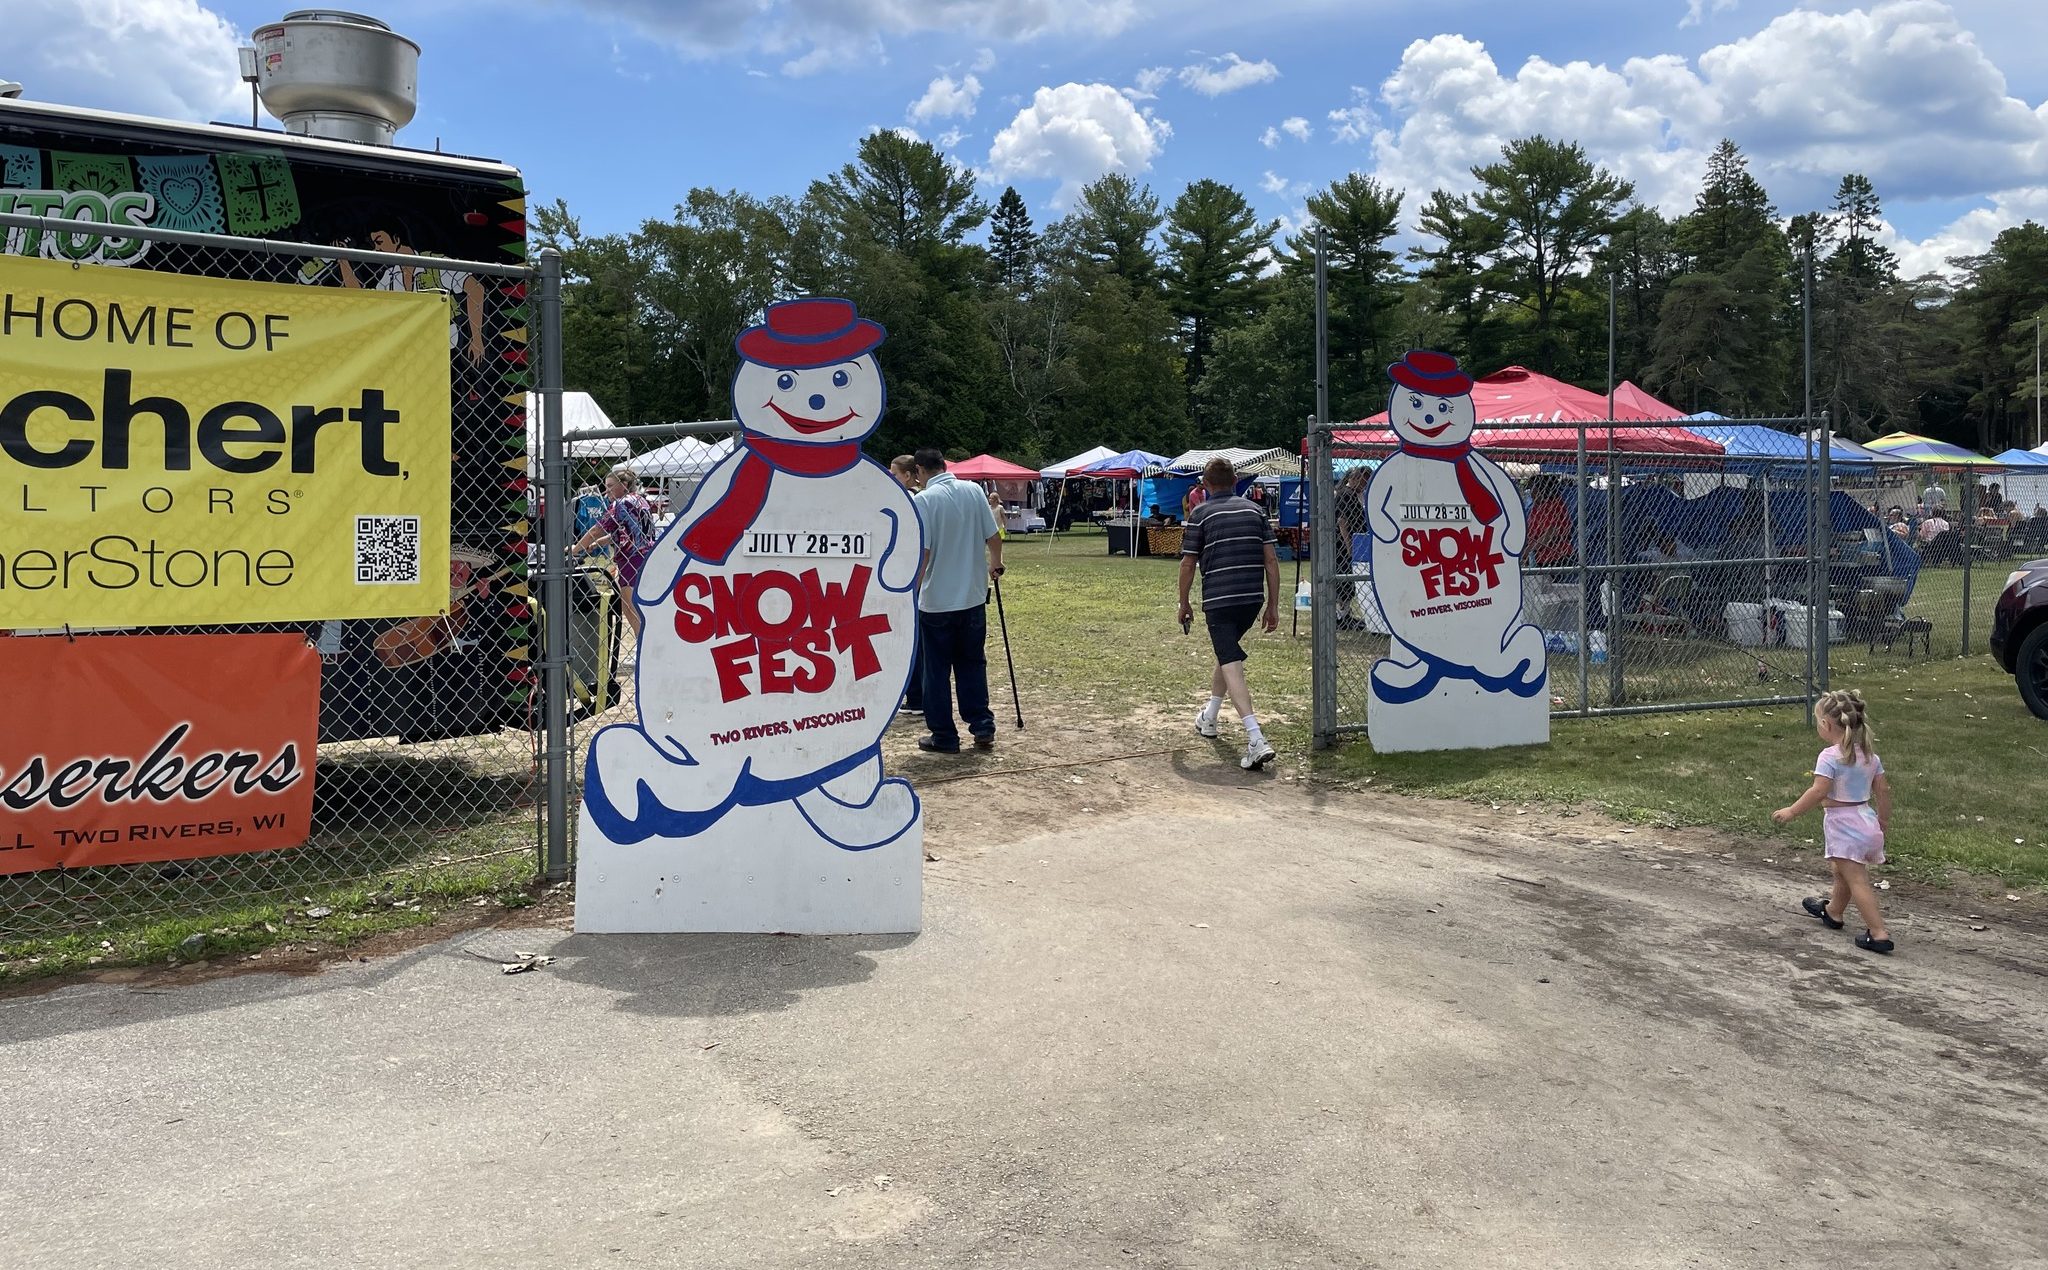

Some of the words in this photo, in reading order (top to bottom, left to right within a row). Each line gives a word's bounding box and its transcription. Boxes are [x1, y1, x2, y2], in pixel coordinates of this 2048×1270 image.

[4, 294, 194, 348] HOME
[215, 311, 290, 352] OF
[1403, 505, 1432, 520] JULY
[1434, 505, 1468, 520] 28-30
[748, 533, 797, 553] JULY
[806, 534, 865, 555] 28-30
[1400, 525, 1495, 567] SNOW
[1420, 553, 1505, 600] FEST
[673, 563, 873, 643] SNOW
[1410, 608, 1426, 619] TWO
[1427, 604, 1453, 615] RIVERS,
[1454, 597, 1493, 611] WISCONSIN
[710, 614, 893, 704] FEST
[710, 730, 741, 746] TWO
[742, 721, 792, 741] RIVERS,
[793, 706, 866, 731] WISCONSIN
[53, 829, 119, 847] TWO
[129, 820, 242, 842] RIVERS,
[252, 812, 286, 832] WI
